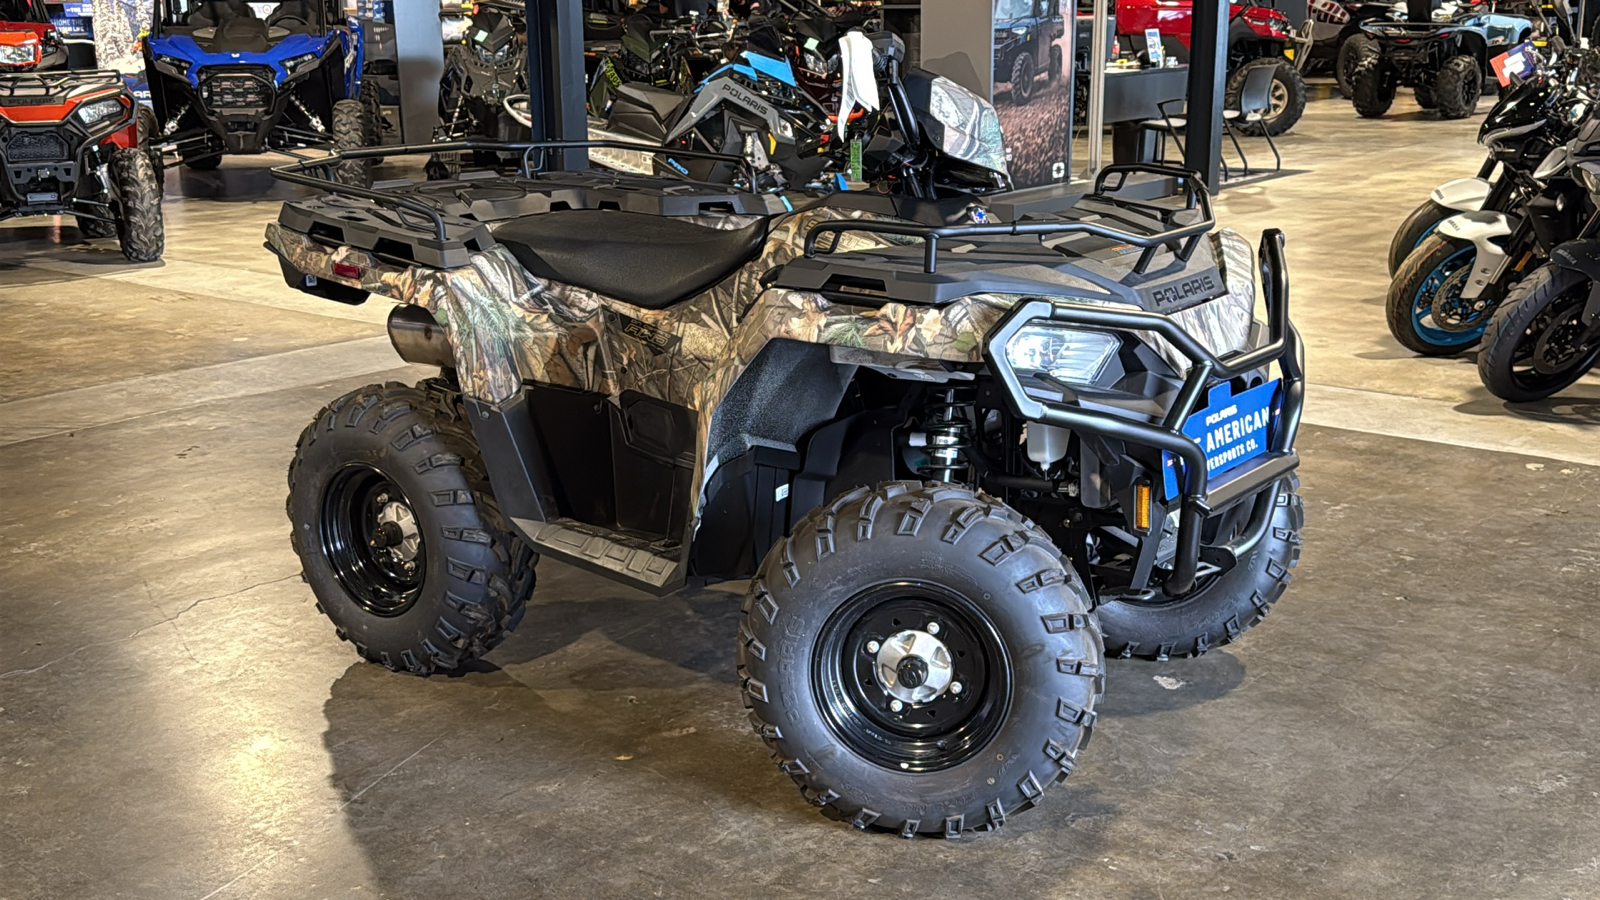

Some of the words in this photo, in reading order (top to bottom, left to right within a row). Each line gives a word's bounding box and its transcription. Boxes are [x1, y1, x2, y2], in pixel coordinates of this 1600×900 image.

[722, 83, 768, 115] POLARIS
[667, 158, 689, 175] PRO
[1152, 275, 1215, 307] POLARIS
[1206, 404, 1237, 426] POLARIS
[1207, 406, 1270, 453] AMERICAN
[1246, 438, 1258, 452] CO.
